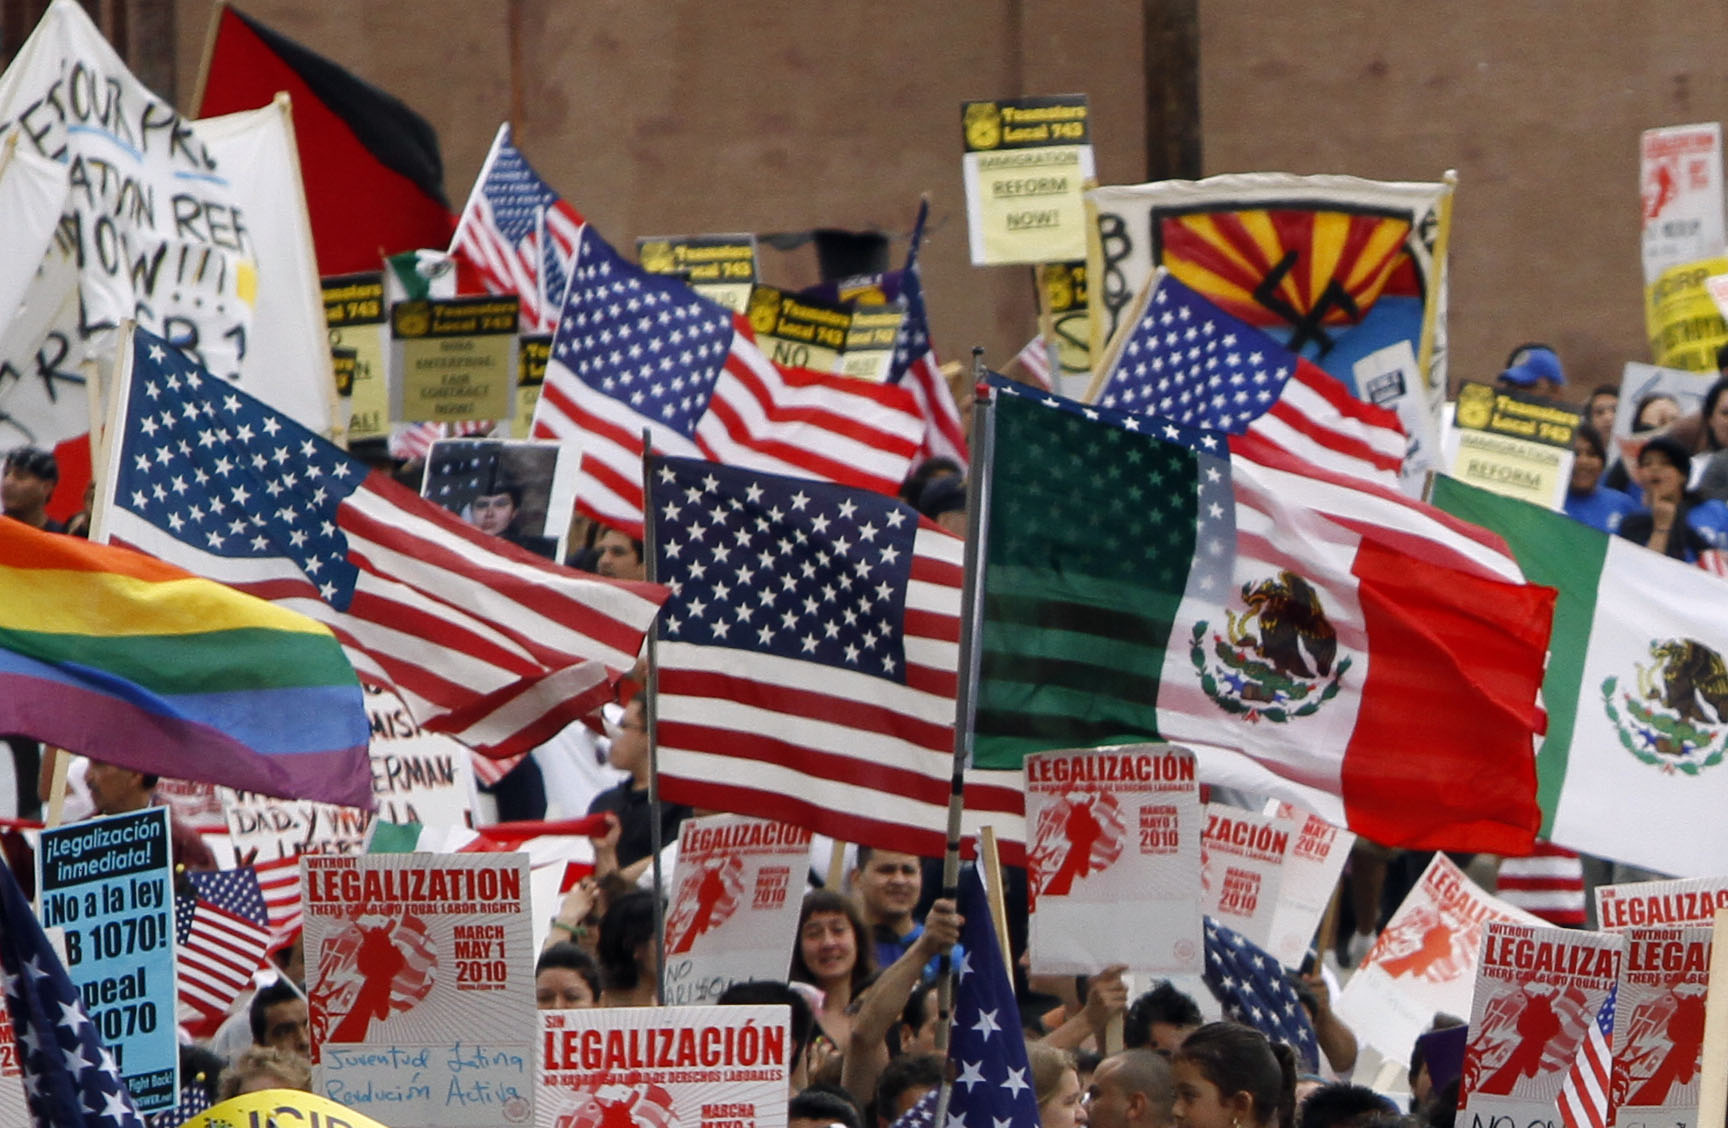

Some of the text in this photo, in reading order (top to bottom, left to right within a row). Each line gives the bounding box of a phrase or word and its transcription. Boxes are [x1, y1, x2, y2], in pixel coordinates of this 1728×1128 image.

[1004, 124, 1046, 141] Local
[991, 177, 1068, 195] REFORM
[1006, 210, 1061, 228] NOW!
[772, 342, 810, 369] NO
[1027, 751, 1196, 782] LEGALIZACIÓN
[1139, 816, 1170, 829] MAYO
[46, 817, 161, 863] ¡Legalización
[1139, 828, 1179, 848] 2010
[1295, 834, 1332, 858] 2010
[57, 841, 152, 882] inmediata!
[307, 857, 358, 869] WITHOUT
[307, 867, 521, 902] LEGALIZATION
[44, 878, 165, 929] ¡No a la ley
[753, 889, 787, 905] 2010
[1220, 888, 1258, 911] 2010
[441, 902, 478, 915] LABOR
[480, 902, 521, 914] RIGHTS
[90, 912, 168, 961] 1070!
[453, 925, 505, 940] MARCH
[1487, 922, 1535, 939] WITHOUT
[1631, 929, 1683, 941] WITHOUT
[454, 941, 506, 960] MAY 1
[456, 961, 508, 983] 2010
[666, 959, 693, 982] NO
[544, 1014, 566, 1029] SIN
[543, 1018, 785, 1071] LEGALIZACIÓN
[723, 1069, 783, 1082] LABORALES
[701, 1103, 756, 1119] MARCHA
